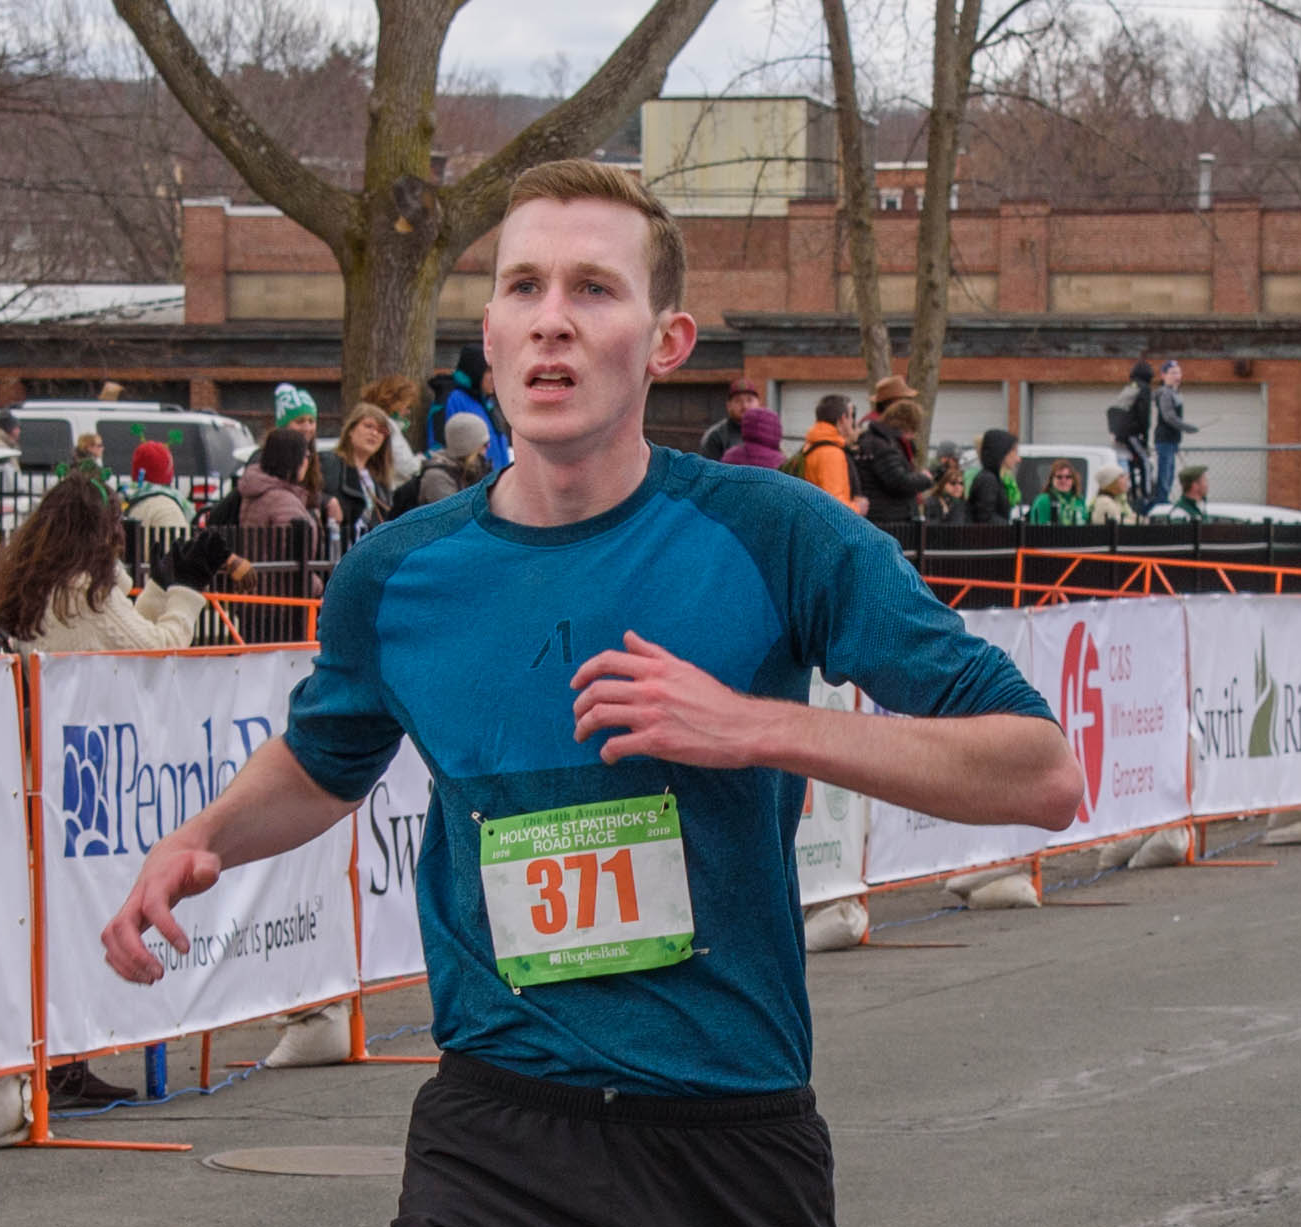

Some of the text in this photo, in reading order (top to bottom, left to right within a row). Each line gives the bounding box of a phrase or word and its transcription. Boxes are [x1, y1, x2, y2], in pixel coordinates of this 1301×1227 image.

[1108, 643, 1132, 682] C&S
[1110, 701, 1165, 738] Wholesale
[1193, 677, 1245, 761] Swift
[1113, 762, 1155, 798] Grocers
[500, 825, 559, 845] HOLYOKE
[533, 831, 618, 854] ROAD RACE
[646, 826, 671, 838] 2019
[526, 848, 640, 936] 371
[193, 923, 217, 967] for
[250, 922, 262, 954] is
[265, 901, 317, 962] possible
